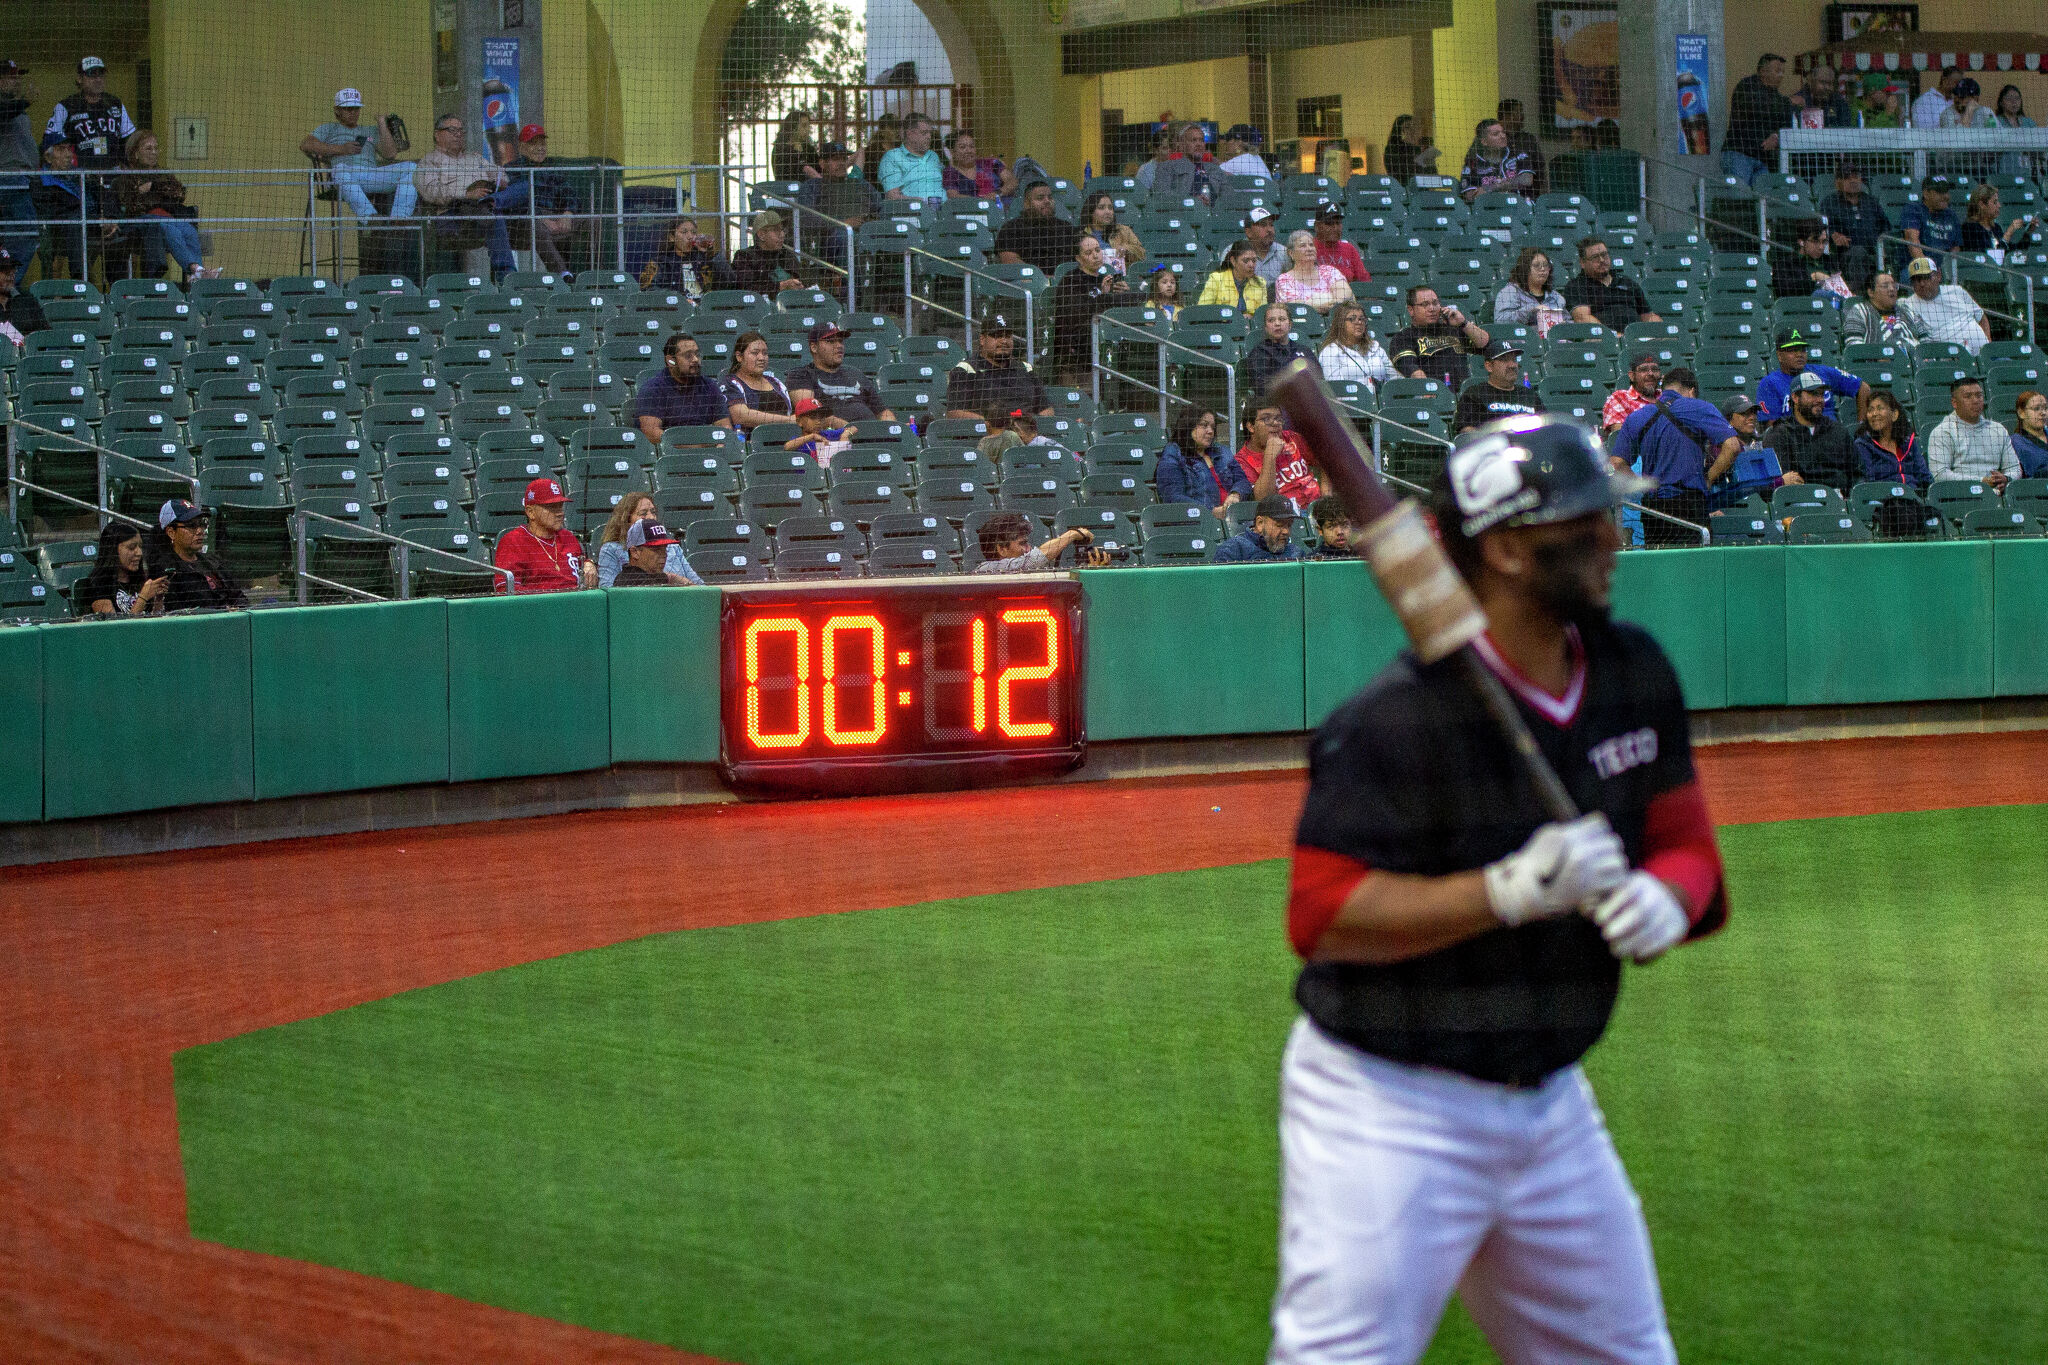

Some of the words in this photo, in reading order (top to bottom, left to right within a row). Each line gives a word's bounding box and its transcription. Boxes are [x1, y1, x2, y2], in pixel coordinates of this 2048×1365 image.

[485, 42, 518, 50] THAT'S
[1679, 38, 1706, 46] THAT'S
[1791, 329, 1802, 339] A
[1275, 458, 1308, 489] ECOS
[745, 608, 1058, 749] 00:12
